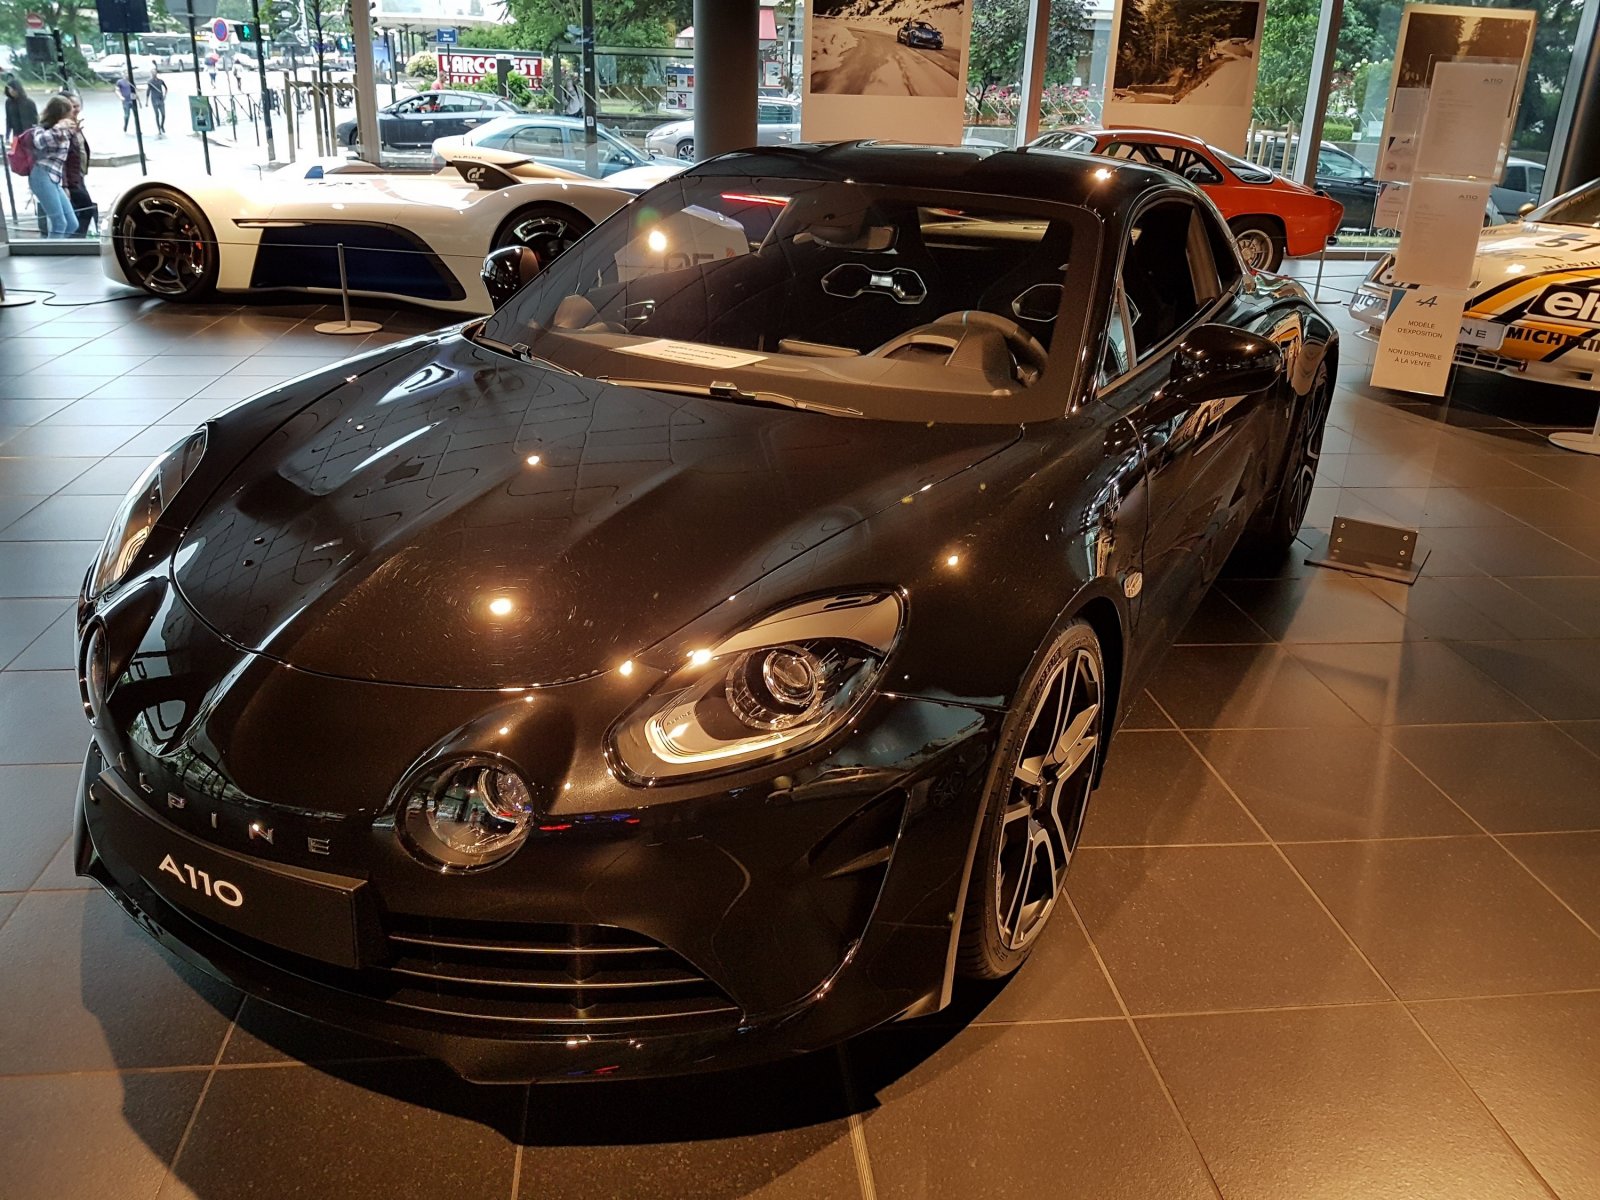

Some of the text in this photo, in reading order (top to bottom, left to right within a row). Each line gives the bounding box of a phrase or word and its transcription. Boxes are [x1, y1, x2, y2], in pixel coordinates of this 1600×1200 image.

[1505, 326, 1600, 352] MICHLI
[1388, 347, 1442, 361] NON DISPONIBLE
[1410, 359, 1432, 368] VENTE
[158, 853, 244, 907] A110
